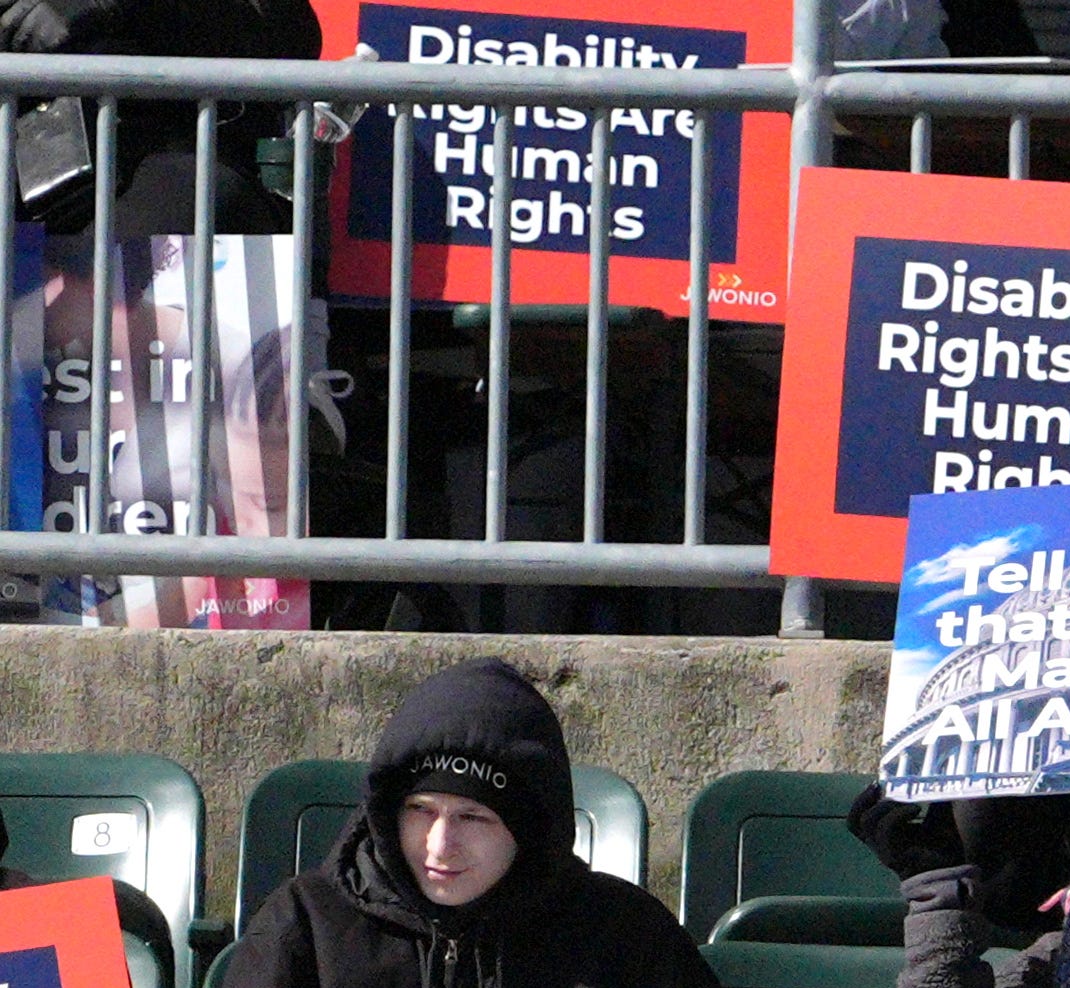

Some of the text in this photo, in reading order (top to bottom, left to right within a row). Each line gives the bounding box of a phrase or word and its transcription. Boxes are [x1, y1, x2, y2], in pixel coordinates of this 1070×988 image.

[446, 187, 645, 243] Rghs
[680, 286, 777, 307] JWONIO
[952, 550, 1064, 595] Tell
[195, 598, 289, 617] JAWONIO
[923, 699, 1021, 745] All
[410, 754, 507, 789] JAWONIO
[93, 820, 111, 848] 8
